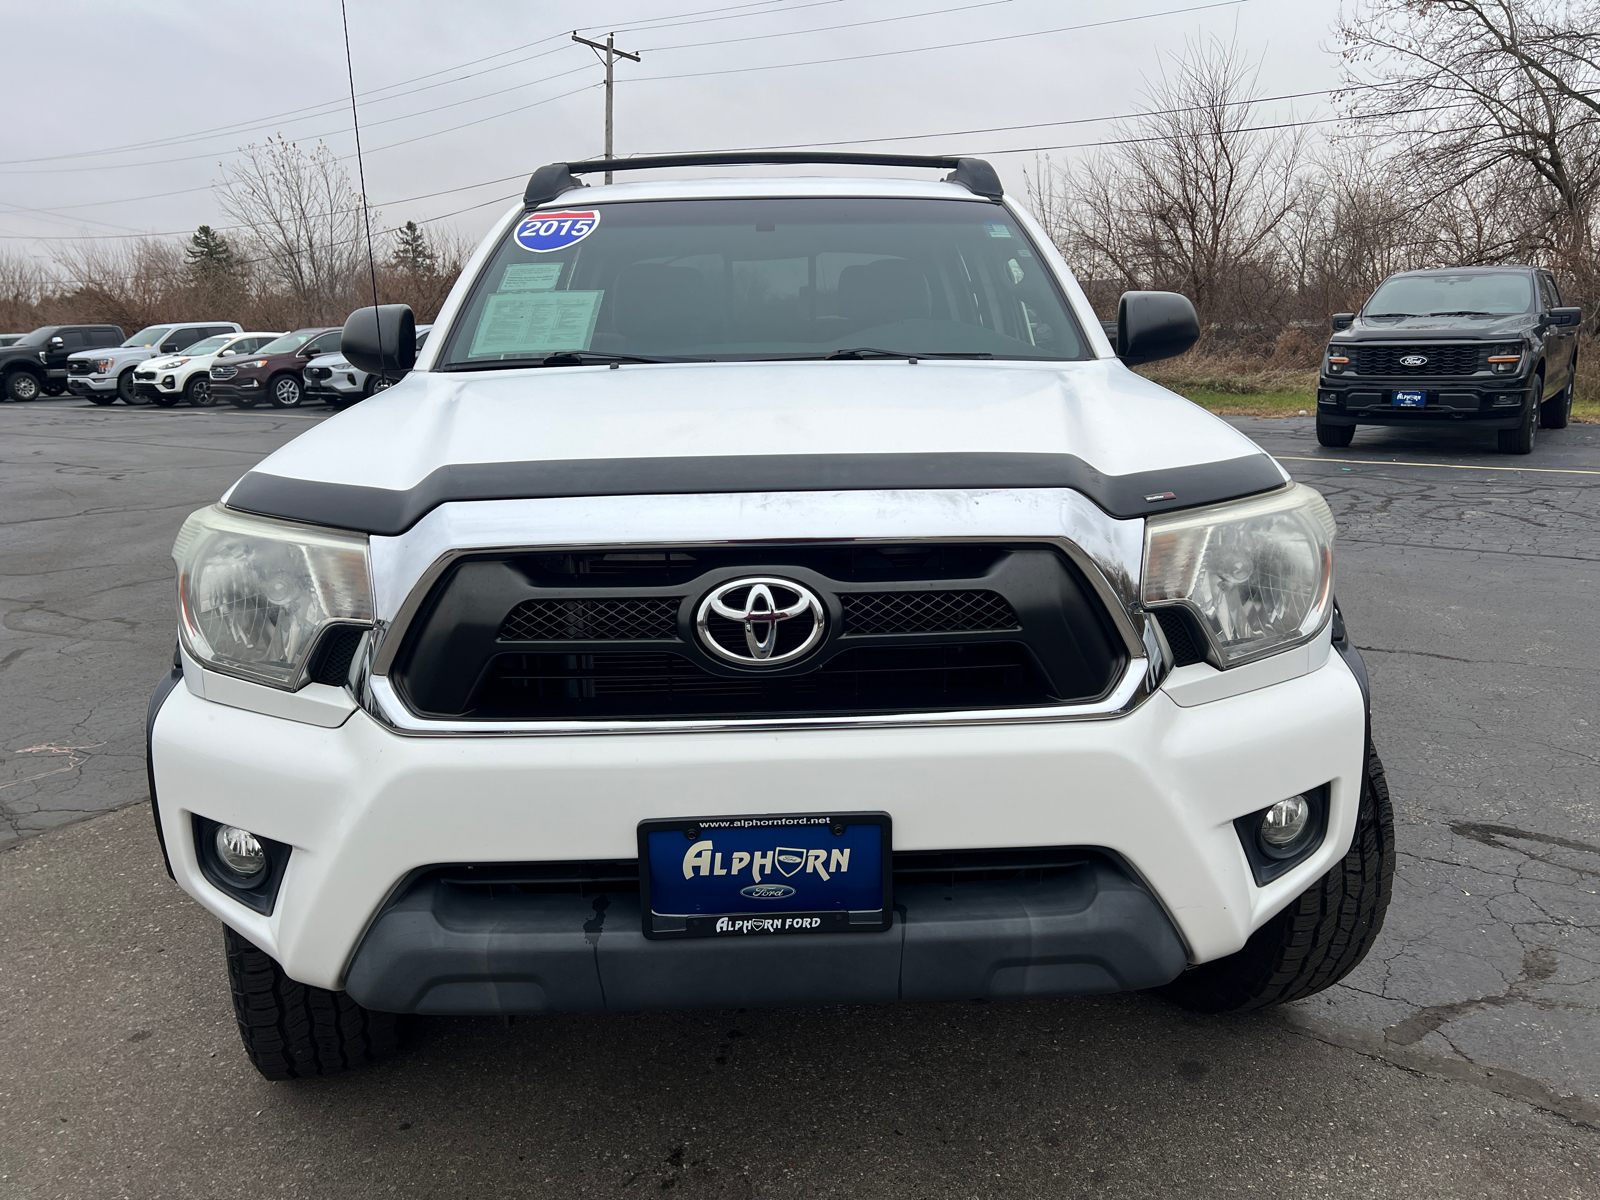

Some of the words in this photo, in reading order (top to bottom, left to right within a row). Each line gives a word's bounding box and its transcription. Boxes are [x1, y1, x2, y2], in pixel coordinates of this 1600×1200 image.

[519, 220, 592, 236] 2015
[1404, 356, 1422, 364] Ford
[699, 817, 831, 828] www.alphornford.net
[752, 886, 784, 898] Ford
[715, 917, 782, 933] ALPHORN
[785, 917, 821, 929] FORD
